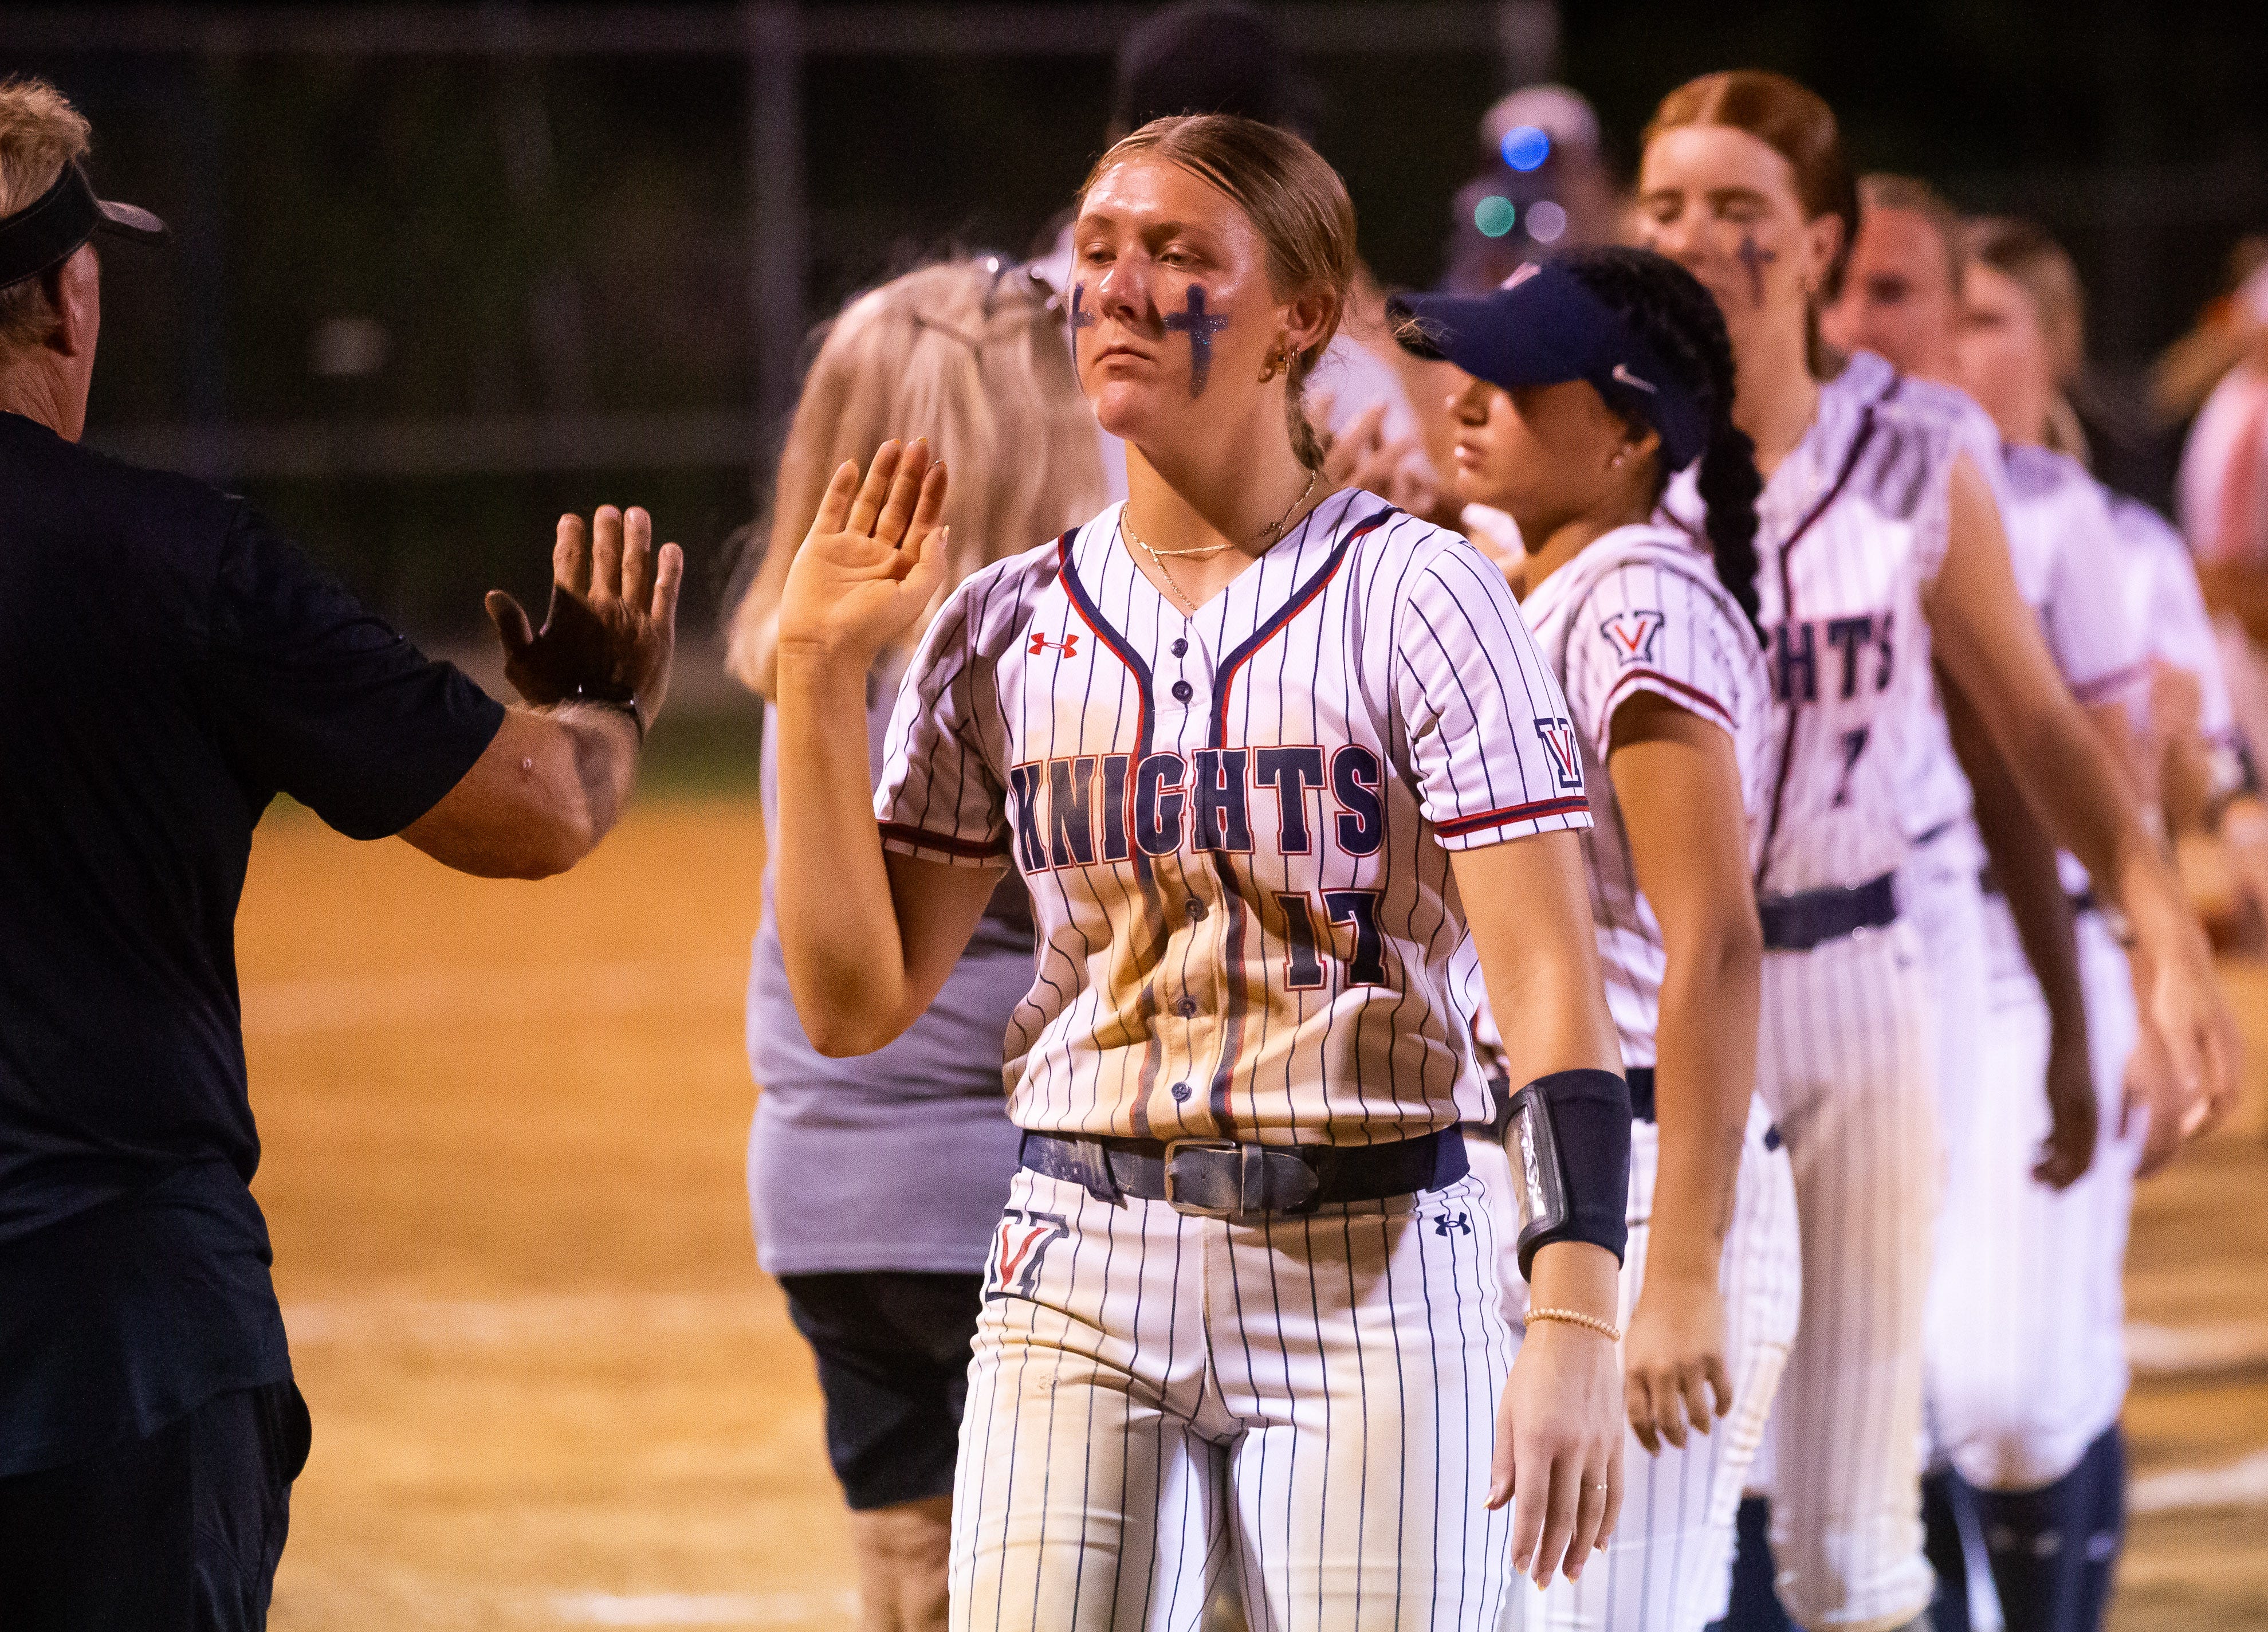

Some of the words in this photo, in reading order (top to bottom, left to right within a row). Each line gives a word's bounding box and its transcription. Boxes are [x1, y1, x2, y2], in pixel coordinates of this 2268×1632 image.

[1768, 613, 1893, 701] HTS
[1010, 745, 1385, 876] KNIGHTS
[1273, 888, 1389, 992] 17
